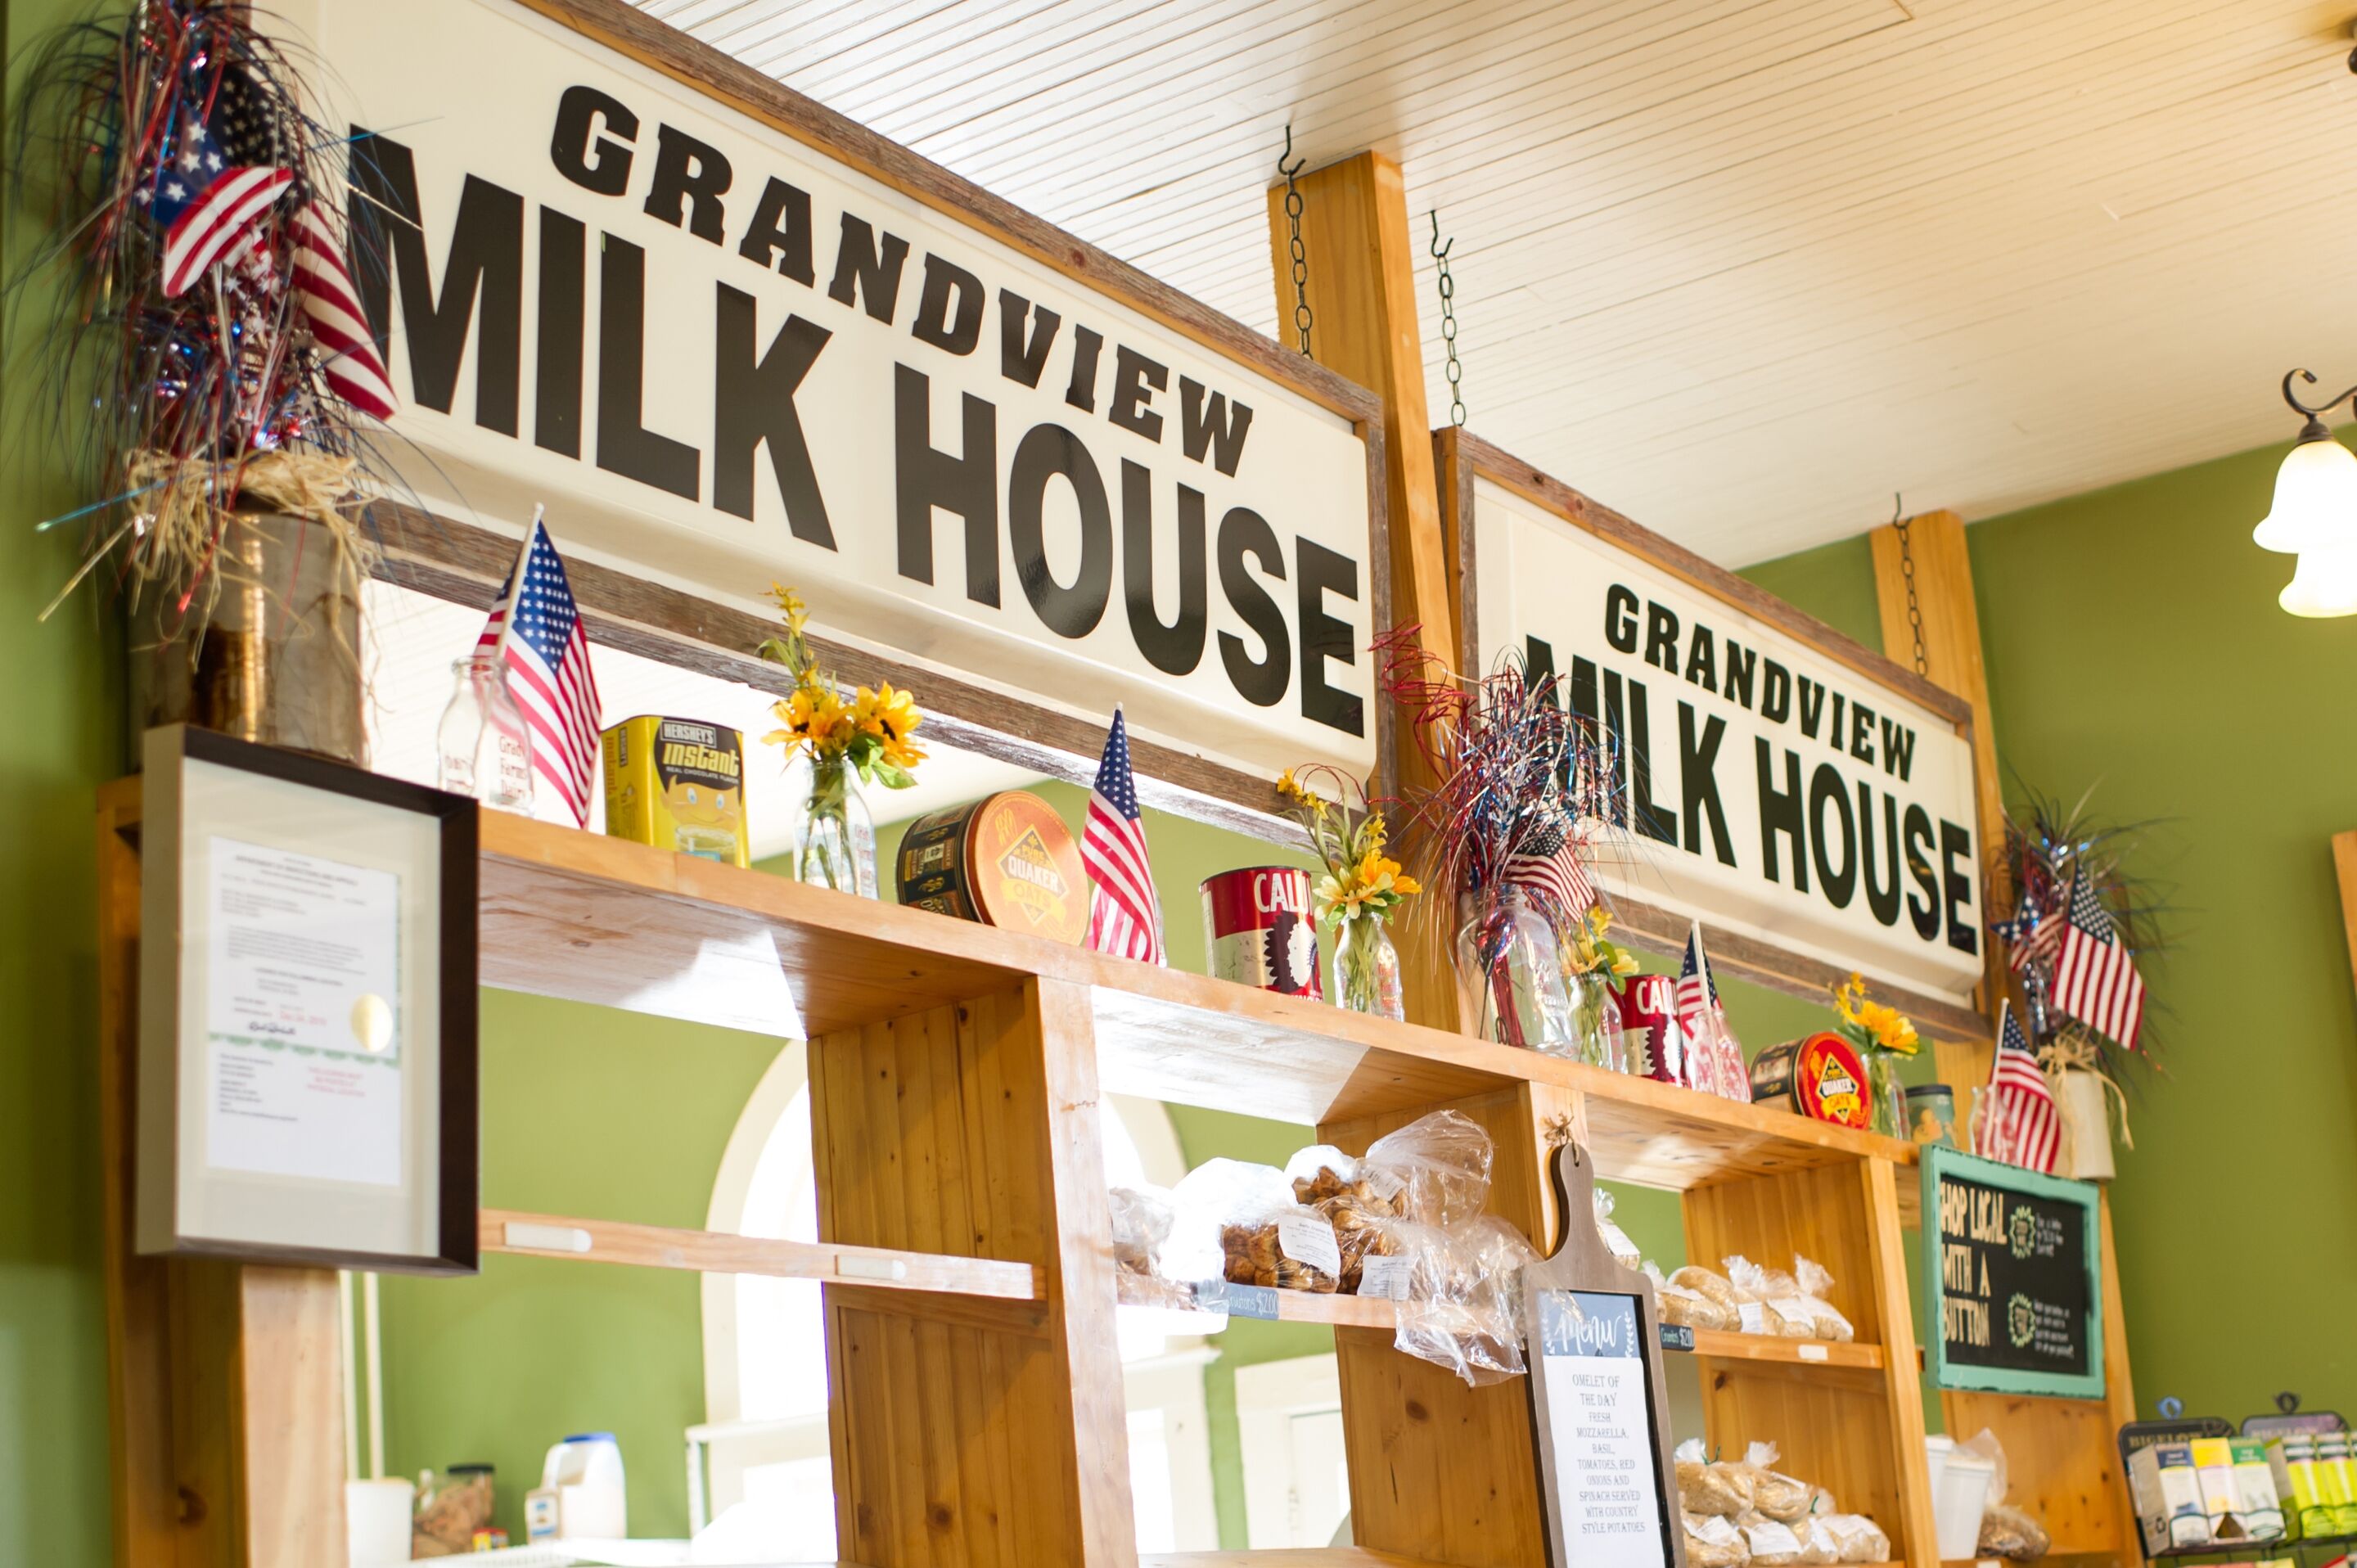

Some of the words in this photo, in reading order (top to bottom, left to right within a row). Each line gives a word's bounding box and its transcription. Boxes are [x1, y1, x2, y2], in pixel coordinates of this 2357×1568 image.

[551, 84, 1254, 477] GRANDVIEW
[349, 124, 837, 552] MILK
[895, 361, 1364, 737] HOUSE
[1605, 583, 1915, 783] GRANDVIEW
[664, 723, 714, 745] HERSHEY'S
[1526, 634, 1737, 869] MILK
[1755, 735, 1977, 956] HOUSE
[1007, 854, 1059, 892] QUAKER
[1013, 883, 1051, 907] OATS
[1822, 1077, 1855, 1097] QUAKER
[1969, 1187, 2008, 1245] LOCAL
[1942, 1243, 1972, 1294] WITH
[1979, 1250, 1991, 1297] A
[1572, 1374, 1605, 1387] OMELET
[1607, 1376, 1620, 1388] OF
[1580, 1394, 1596, 1406] THE
[1597, 1393, 1617, 1407] DAY
[1589, 1412, 1611, 1422] FRESH
[1619, 1459, 1635, 1470] RED
[1586, 1475, 1612, 1485] ONIONS
[1613, 1475, 1630, 1485] AND
[1579, 1491, 1611, 1501] SPINACH
[1611, 1489, 1641, 1501] SERVED
[1585, 1507, 1604, 1517] WITH
[1604, 1505, 1638, 1517] COUNTRY
[1581, 1522, 1606, 1534] STYLE
[1607, 1522, 1646, 1533] POTATOES
